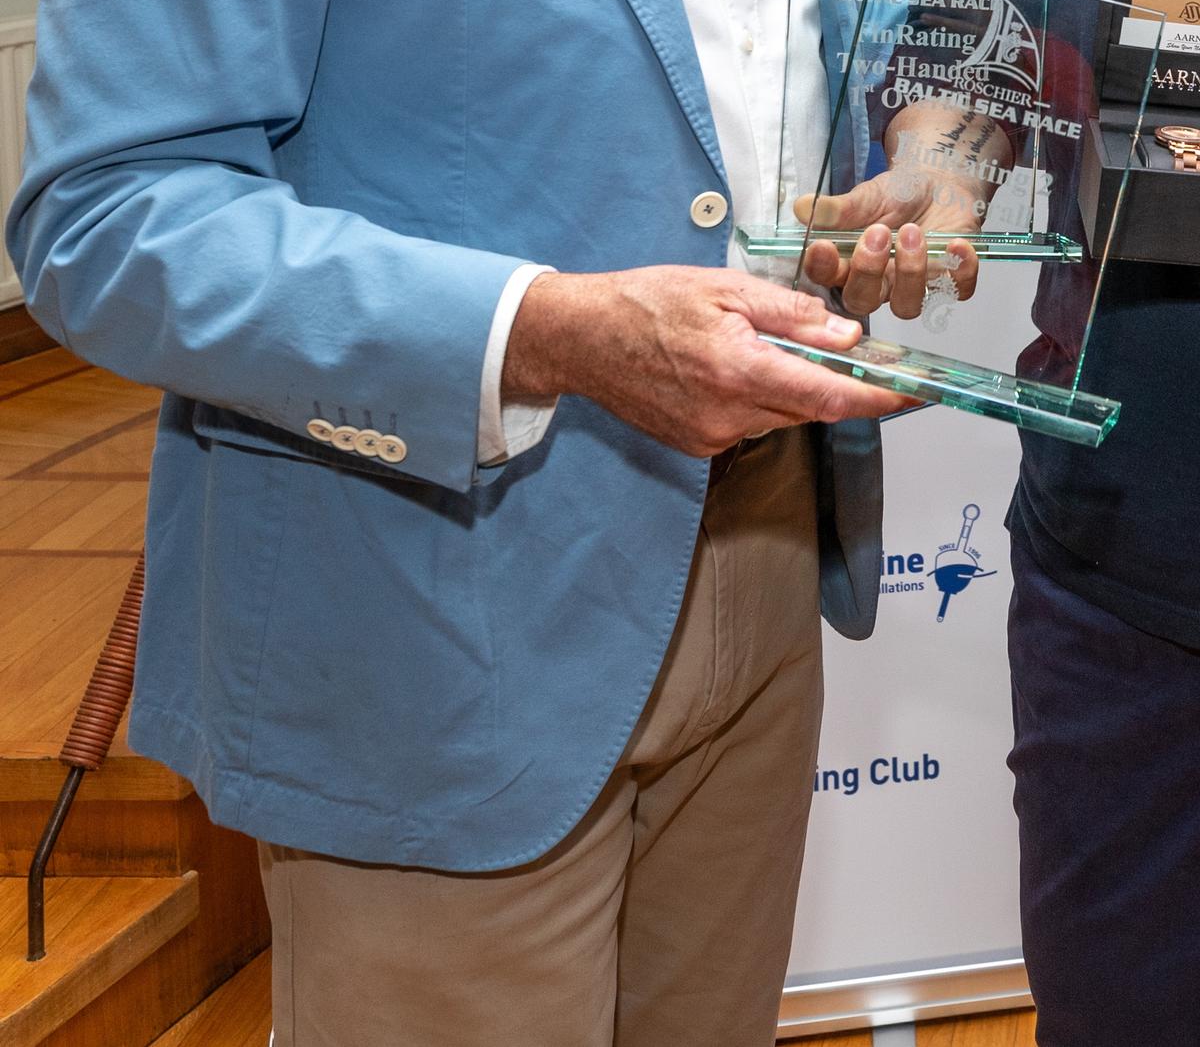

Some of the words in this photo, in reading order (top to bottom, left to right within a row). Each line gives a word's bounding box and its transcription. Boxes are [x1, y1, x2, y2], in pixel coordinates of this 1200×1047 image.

[953, 77, 1033, 109] ROSCHIER
[974, 99, 1018, 123] SEA
[1022, 110, 1083, 140] RACE
[869, 753, 940, 785] Club
